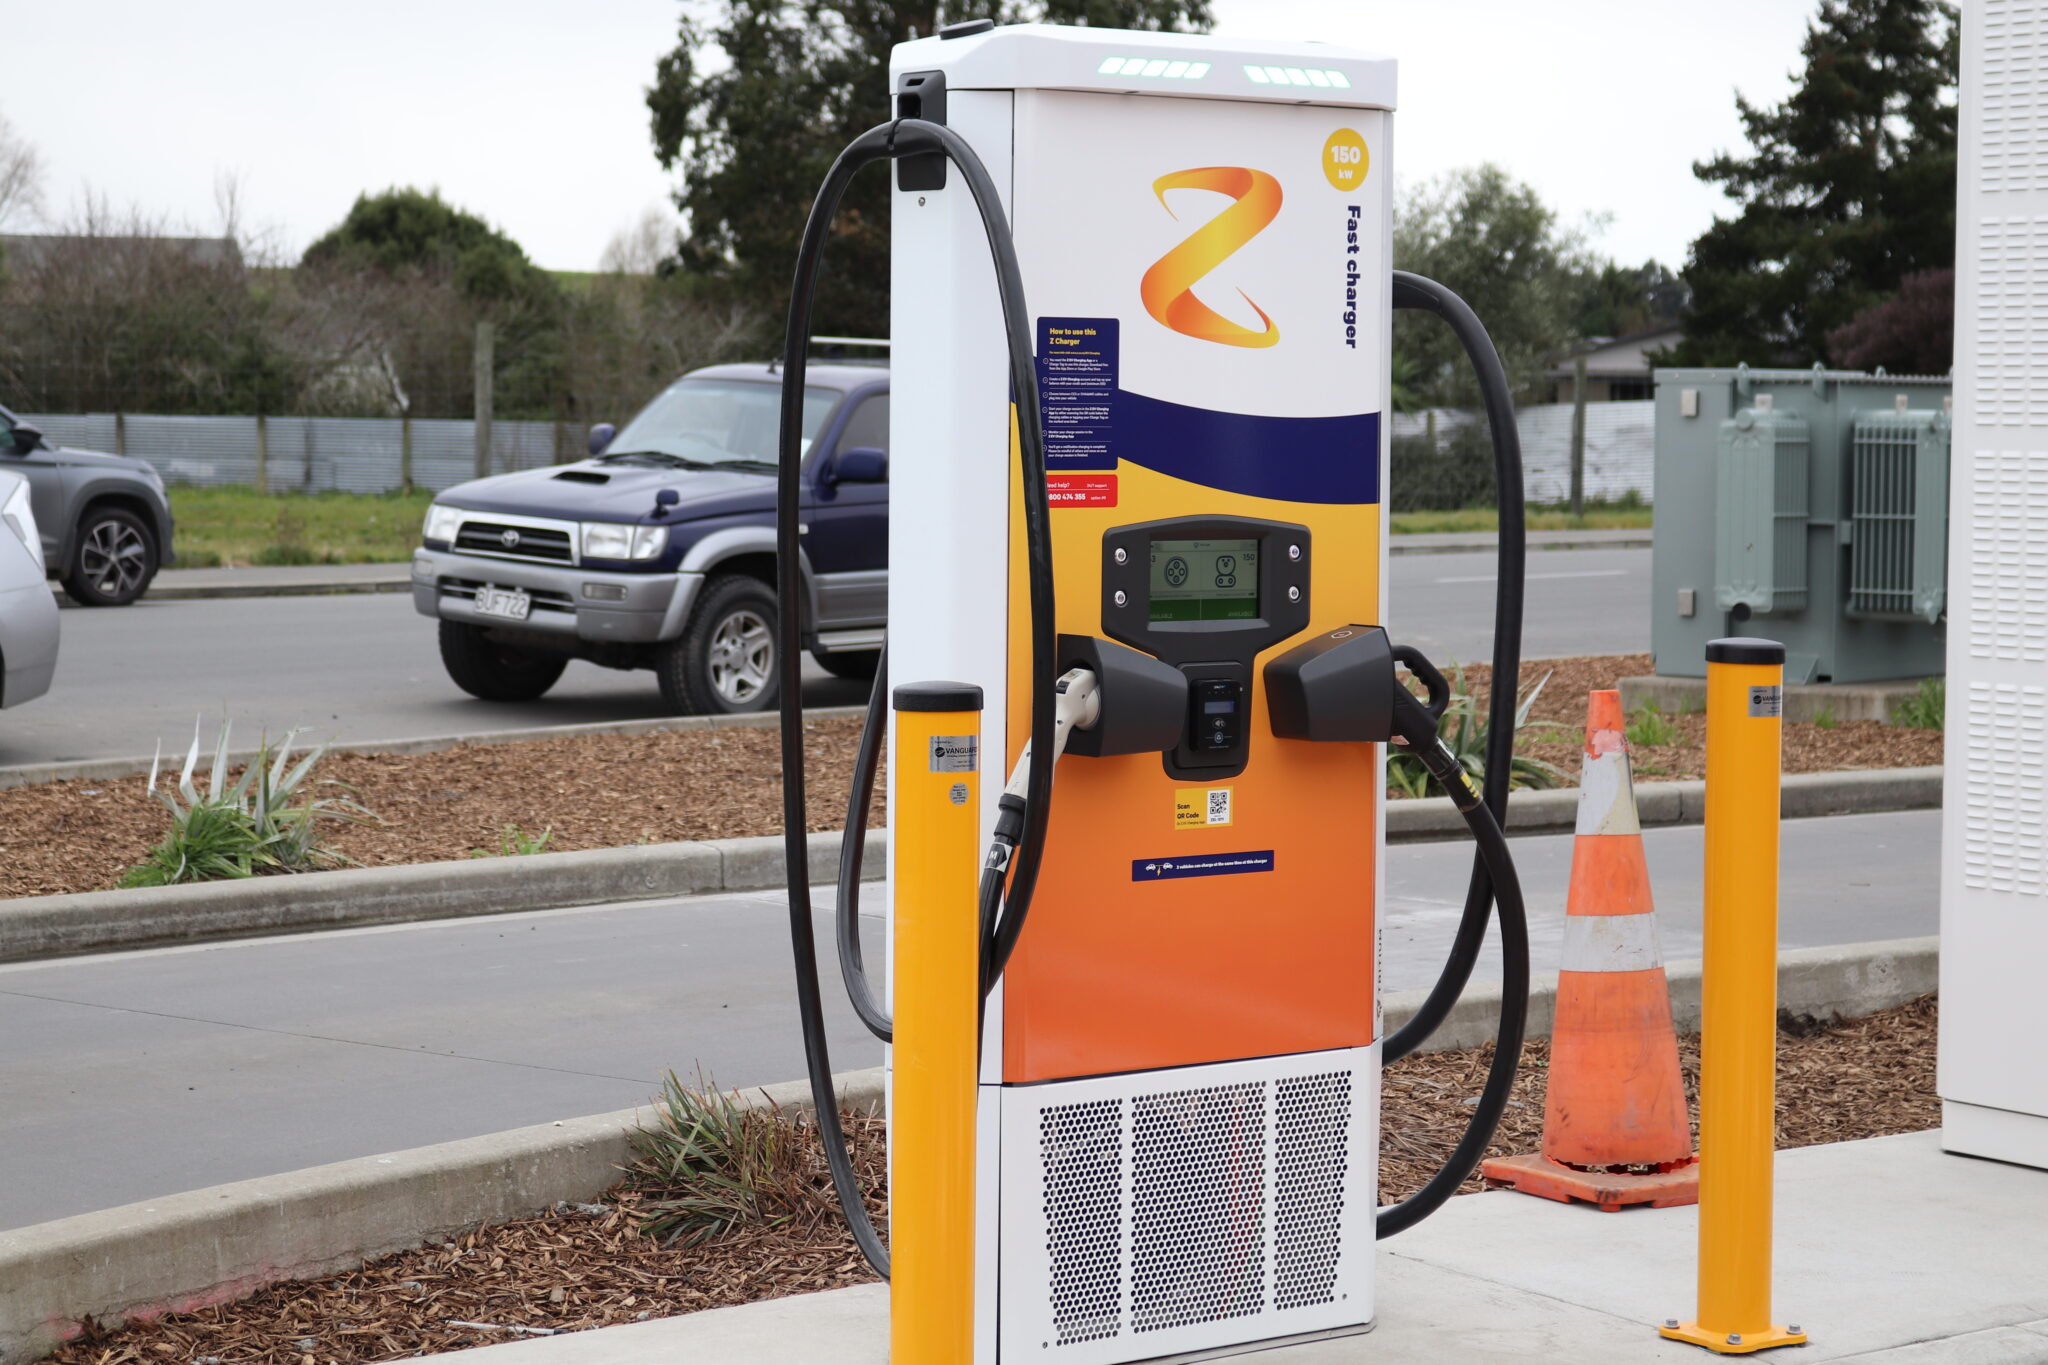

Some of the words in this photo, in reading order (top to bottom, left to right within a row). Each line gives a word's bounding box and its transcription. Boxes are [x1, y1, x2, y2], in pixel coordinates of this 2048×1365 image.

[1331, 146, 1361, 164] 150
[1338, 169, 1353, 180] kW
[1347, 205, 1361, 254] Fast
[1343, 260, 1361, 349] charger
[1049, 327, 1063, 335] How
[1084, 328, 1097, 336] this
[1049, 337, 1054, 345] Z
[1055, 337, 1080, 346] Charger
[1062, 493, 1073, 501] 474
[1074, 493, 1086, 501] 355
[1242, 553, 1255, 561] 150
[989, 850, 998, 860] M
